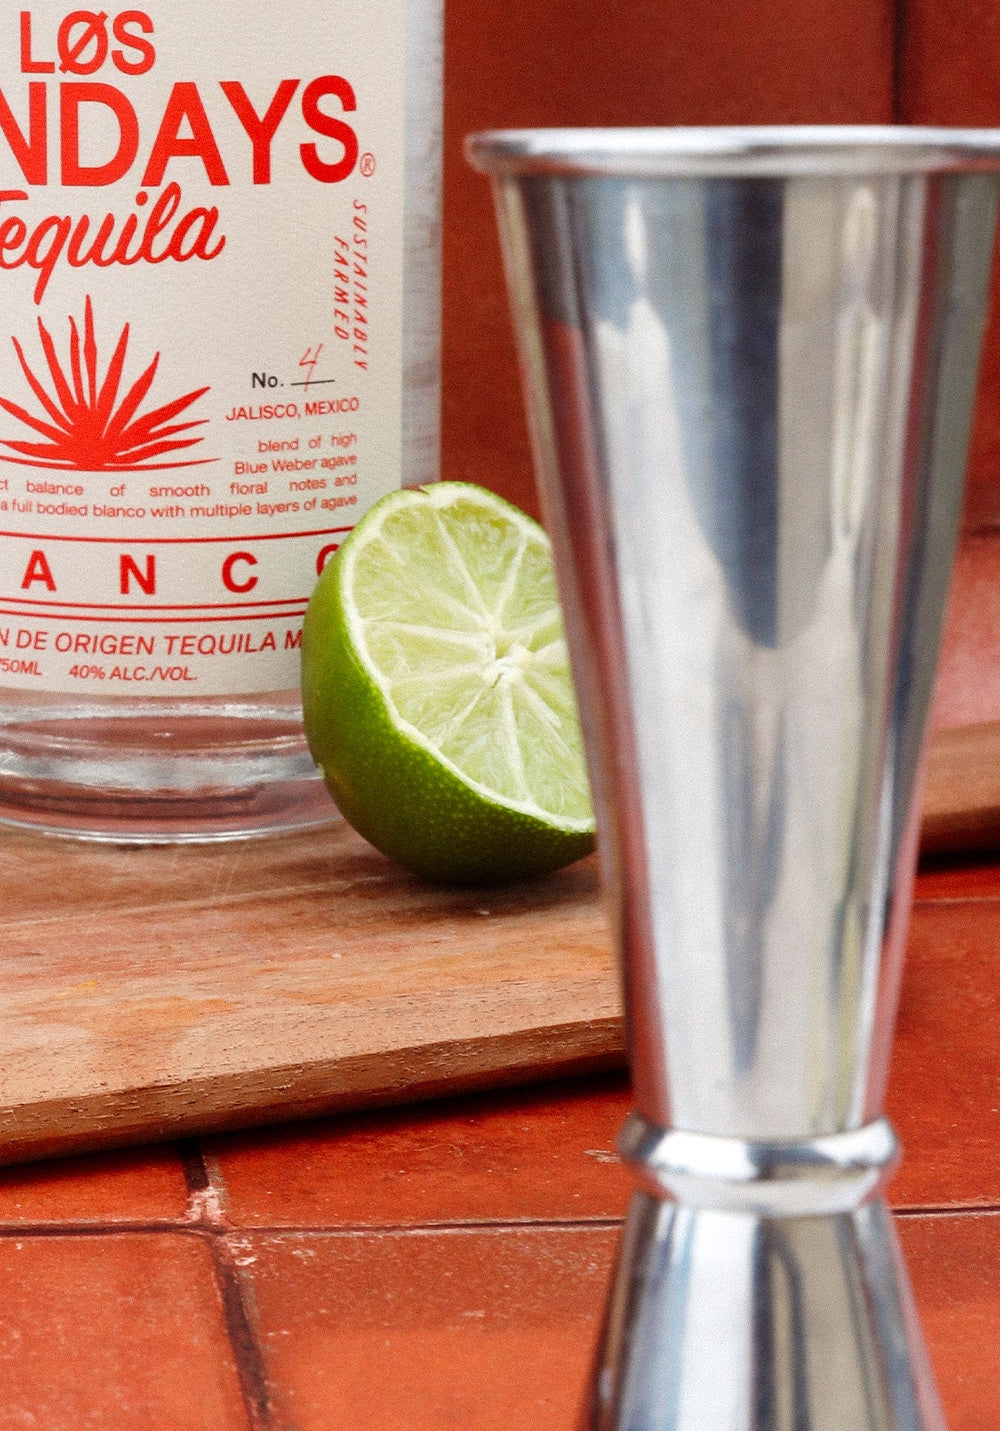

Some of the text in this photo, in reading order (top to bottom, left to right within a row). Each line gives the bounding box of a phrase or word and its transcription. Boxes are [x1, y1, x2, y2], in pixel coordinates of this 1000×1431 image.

[20, 10, 156, 76] LØS
[334, 236, 349, 340] FARMED
[353, 199, 368, 371] SUSTAINABLY
[252, 372, 284, 388] No.
[226, 397, 359, 421] JALISCO, MEXICO
[258, 433, 357, 453] blend of high
[234, 454, 357, 475] Blue Weber agave
[27, 480, 83, 496] balance
[110, 484, 126, 497] of
[150, 483, 210, 497] smooth
[230, 482, 268, 495] floral
[289, 477, 327, 492] notes
[334, 473, 357, 487] and
[0, 501, 8, 511] a
[12, 499, 32, 513] full
[37, 500, 88, 517] bodied
[93, 503, 146, 519] blanco
[151, 503, 185, 518] with
[190, 503, 252, 519] multiple
[257, 501, 299, 516] layers
[304, 497, 317, 511] of
[321, 494, 357, 511] agave
[16, 632, 47, 651] DE
[55, 632, 154, 655] ORIGEN
[165, 634, 275, 655] TEQUILA
[69, 665, 106, 679] 40%
[109, 666, 197, 681] ALC./VOL.
